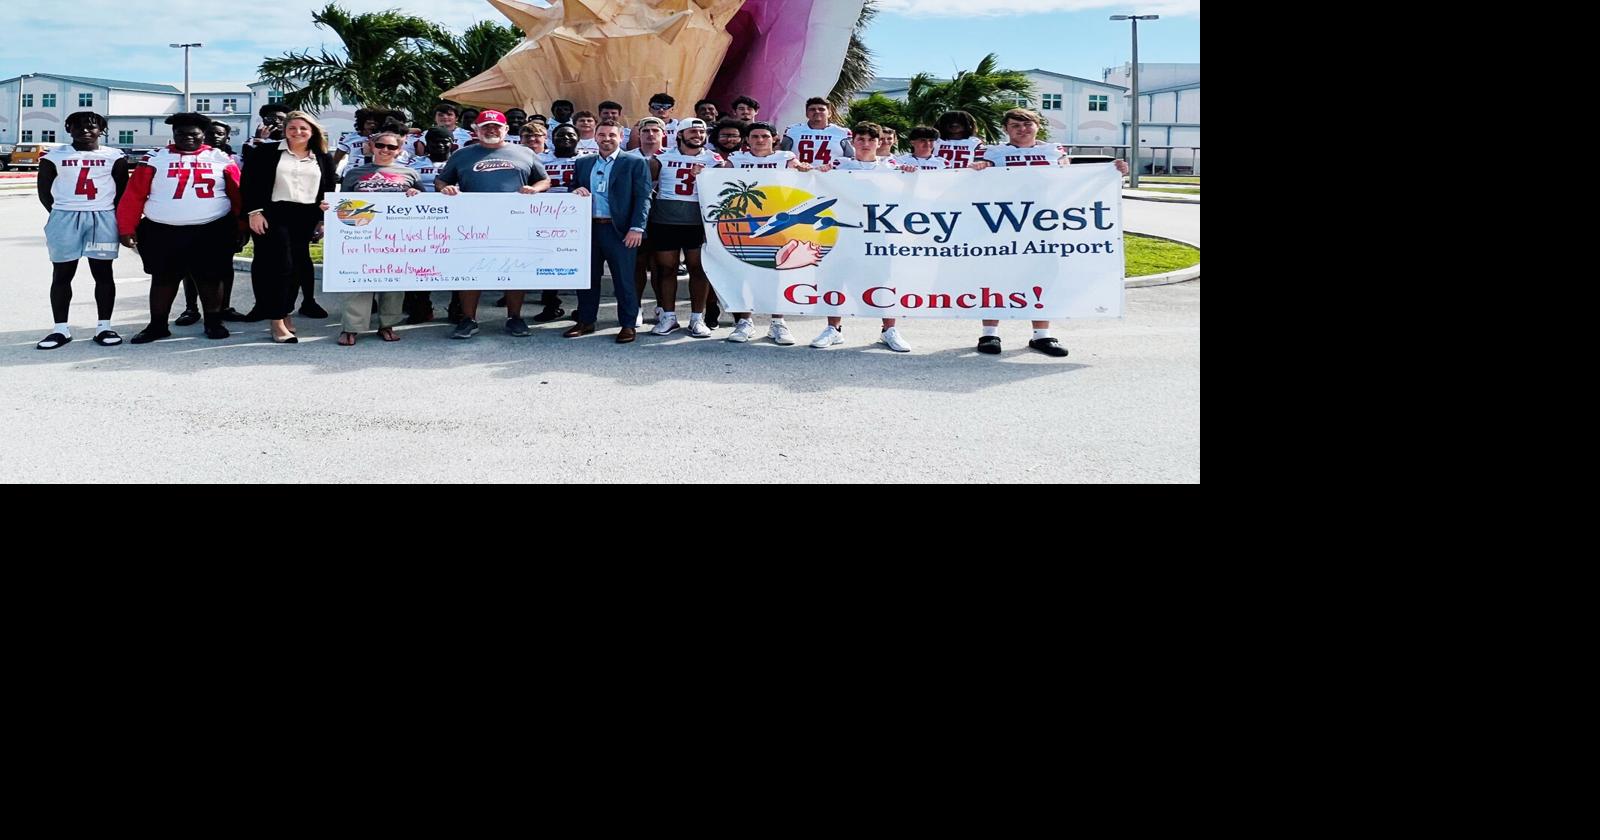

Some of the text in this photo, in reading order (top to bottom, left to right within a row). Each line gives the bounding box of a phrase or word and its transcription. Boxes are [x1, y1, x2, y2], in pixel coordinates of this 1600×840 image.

[798, 140, 832, 164] 64
[74, 167, 98, 200] 4
[167, 169, 215, 199] 75
[675, 168, 695, 195] 3
[386, 205, 449, 216] Key West
[863, 201, 1114, 244] Key West
[374, 227, 397, 246] Key
[864, 240, 1114, 258] International Airport
[784, 283, 1045, 309] Go Conchs!
